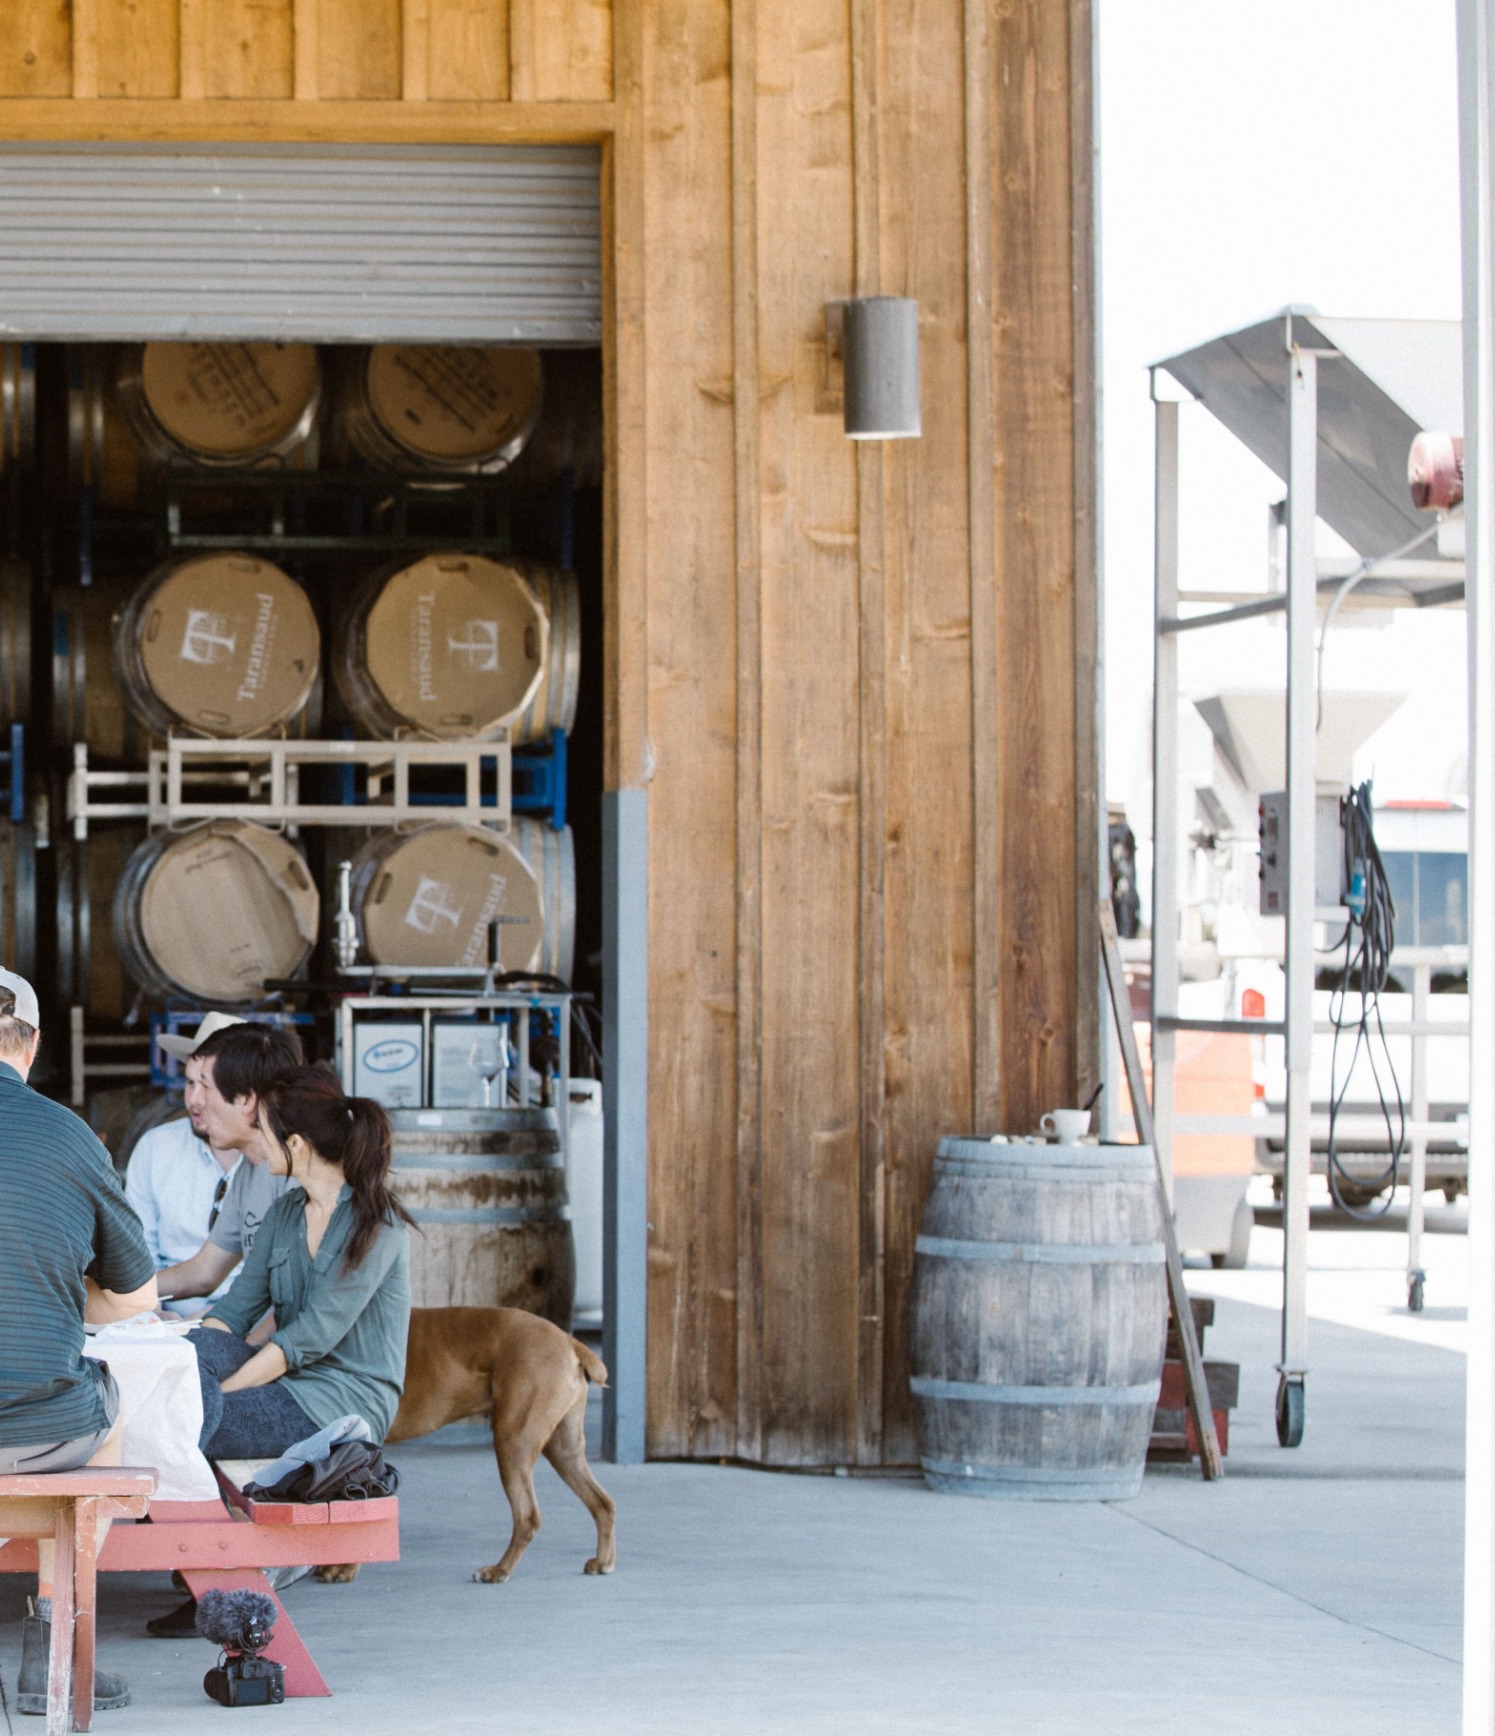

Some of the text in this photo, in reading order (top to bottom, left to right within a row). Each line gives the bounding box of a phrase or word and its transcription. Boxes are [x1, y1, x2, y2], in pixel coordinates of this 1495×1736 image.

[238, 593, 274, 701] Taransaud
[418, 593, 436, 701] Taransaud
[457, 874, 506, 966] aransaud
